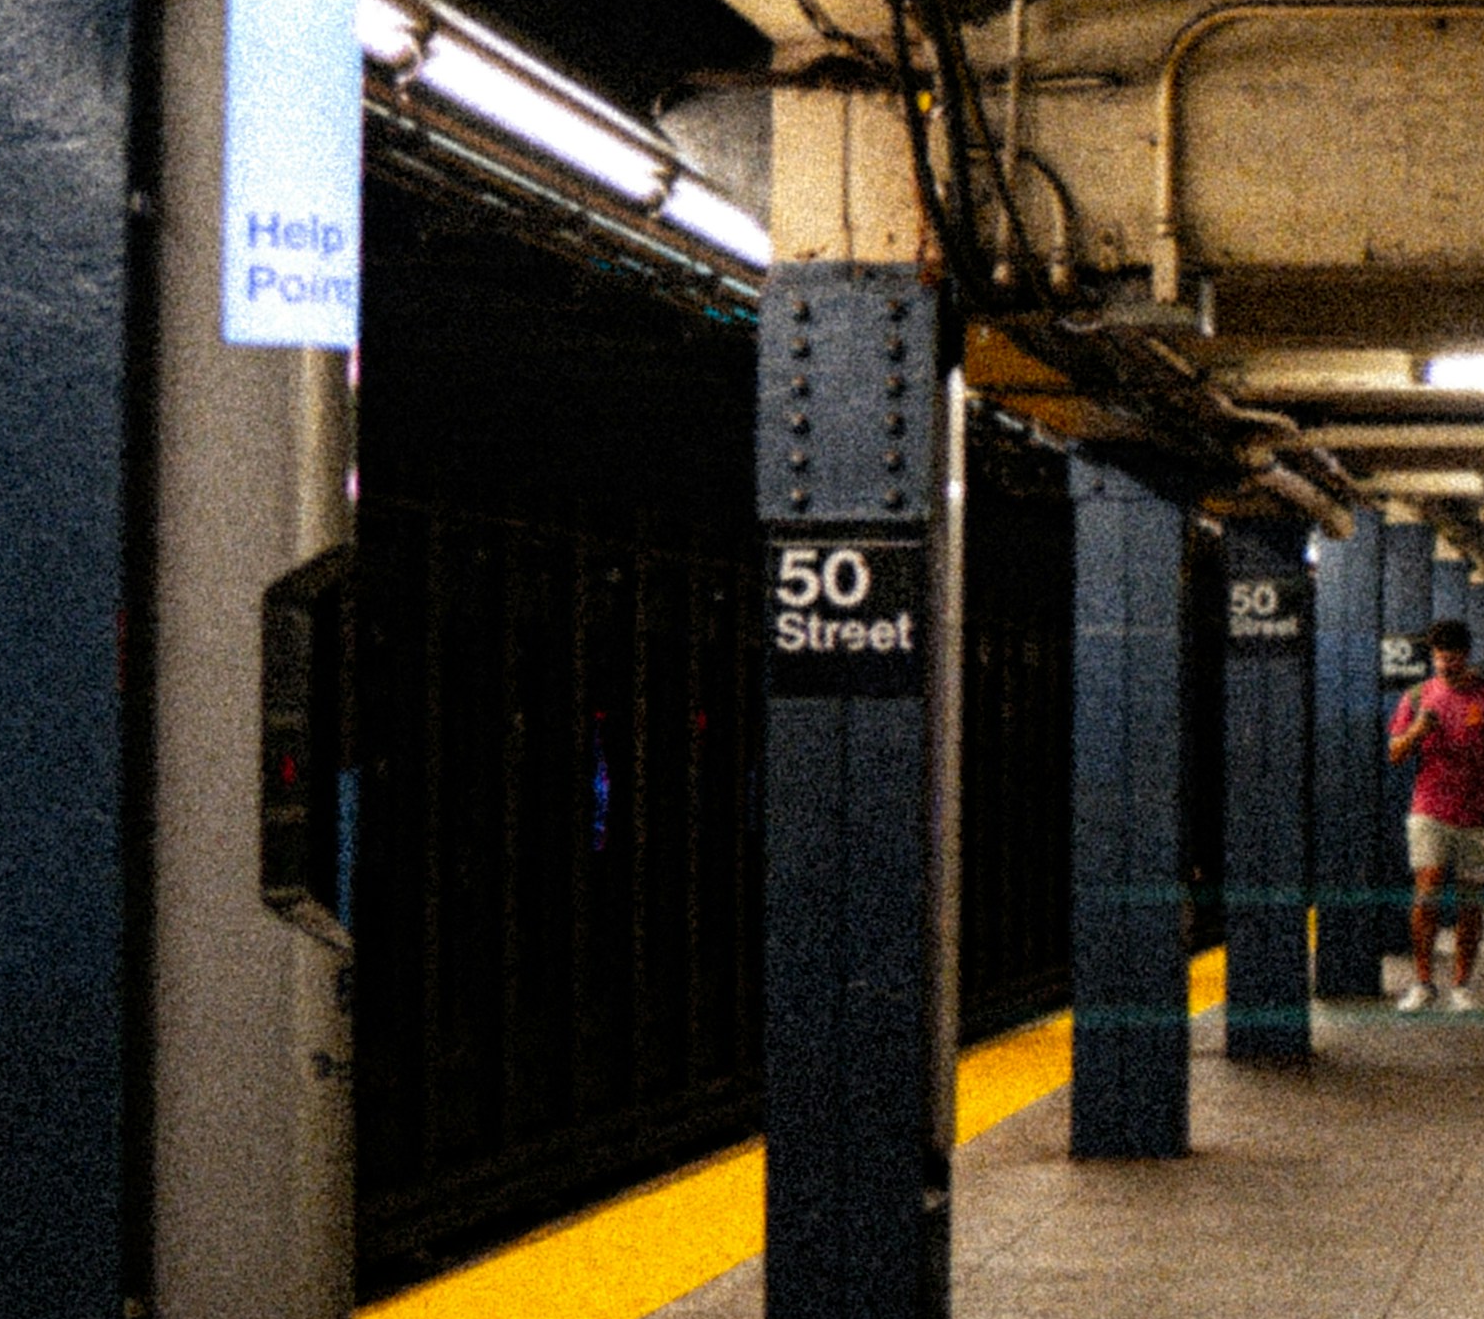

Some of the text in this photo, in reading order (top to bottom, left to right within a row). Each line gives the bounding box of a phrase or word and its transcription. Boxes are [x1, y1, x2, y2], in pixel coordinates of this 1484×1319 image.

[246, 211, 345, 260] Help
[776, 549, 872, 608] 50
[1230, 583, 1279, 616] 50
[775, 611, 913, 653] Street
